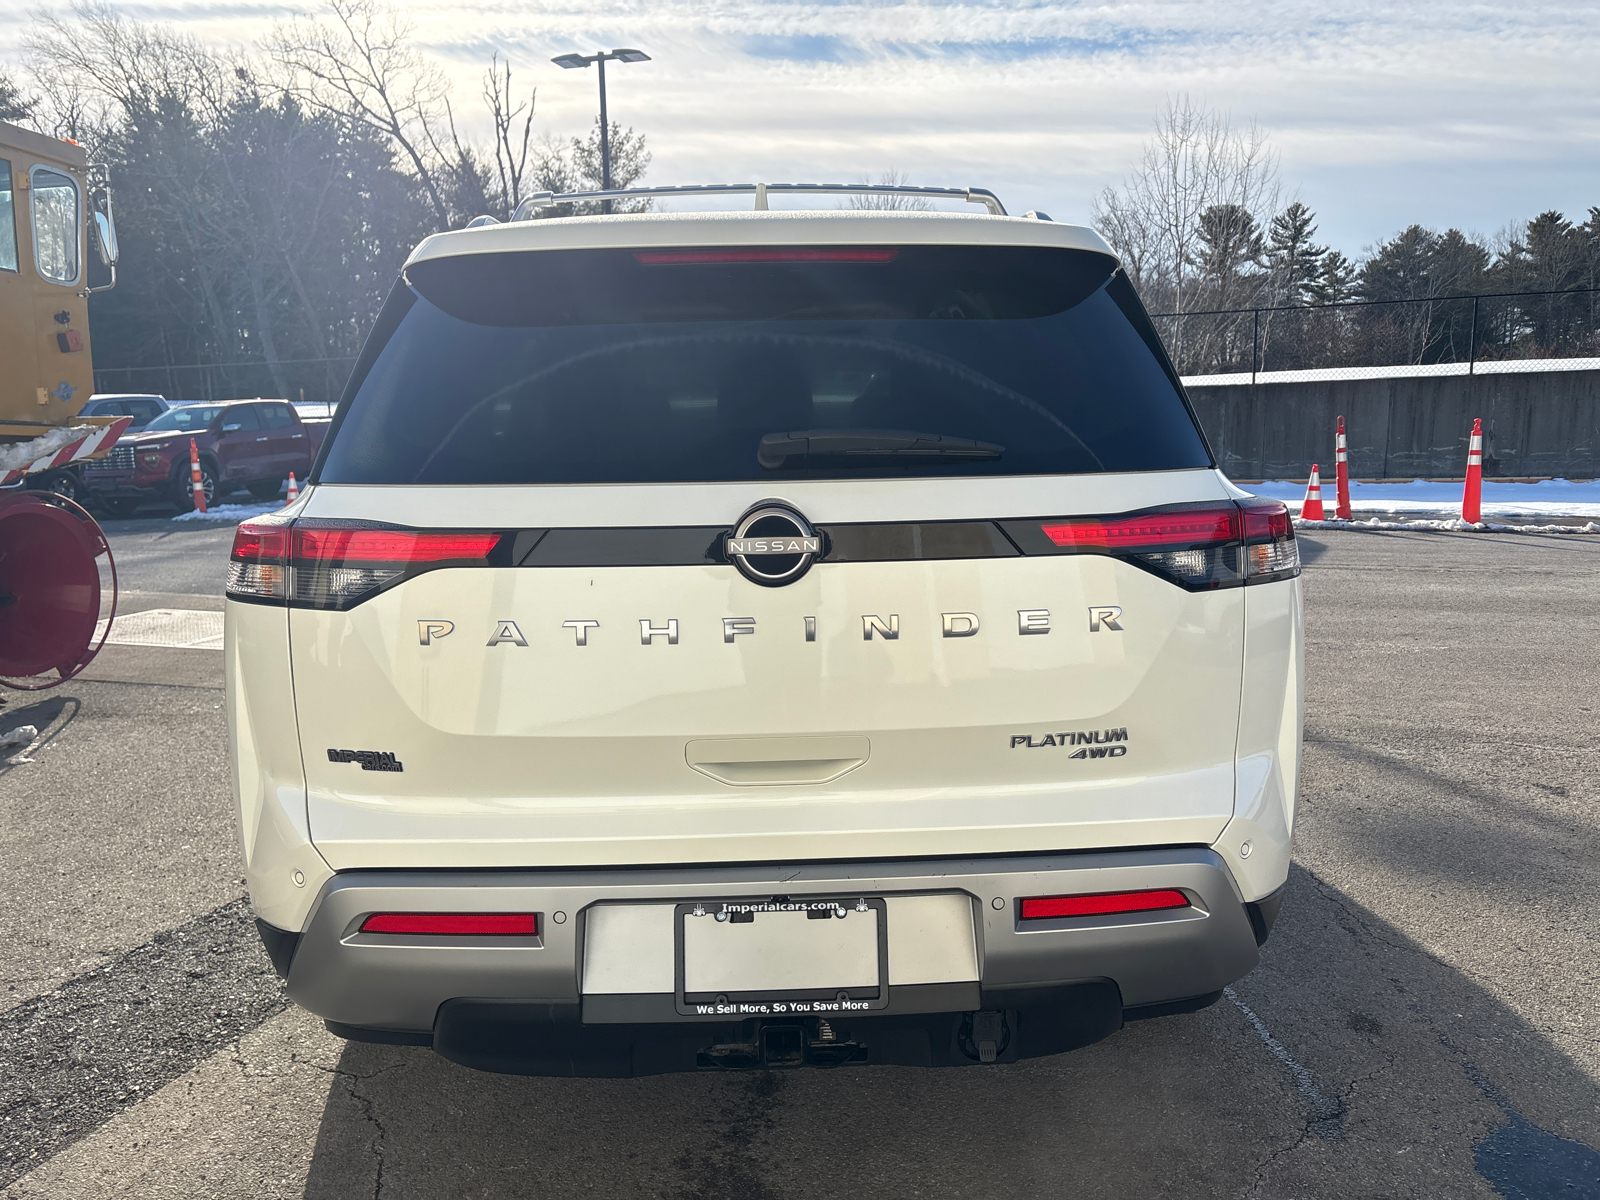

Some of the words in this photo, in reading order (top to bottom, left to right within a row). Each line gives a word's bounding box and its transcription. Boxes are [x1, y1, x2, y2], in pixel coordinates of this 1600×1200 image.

[730, 540, 817, 552] NISSAN
[417, 605, 1124, 647] PATHFINDER
[1010, 727, 1128, 748] PLATINUM
[327, 749, 399, 765] IMPERIAL
[1068, 745, 1127, 759] 4WD
[722, 902, 839, 914] Imperialcars.com
[697, 1005, 714, 1014] We
[717, 1004, 736, 1014] Sell
[740, 1004, 770, 1014] More,
[773, 1003, 787, 1012] So
[790, 1002, 810, 1012] You
[813, 1001, 839, 1011] Save
[842, 1001, 869, 1010] More
